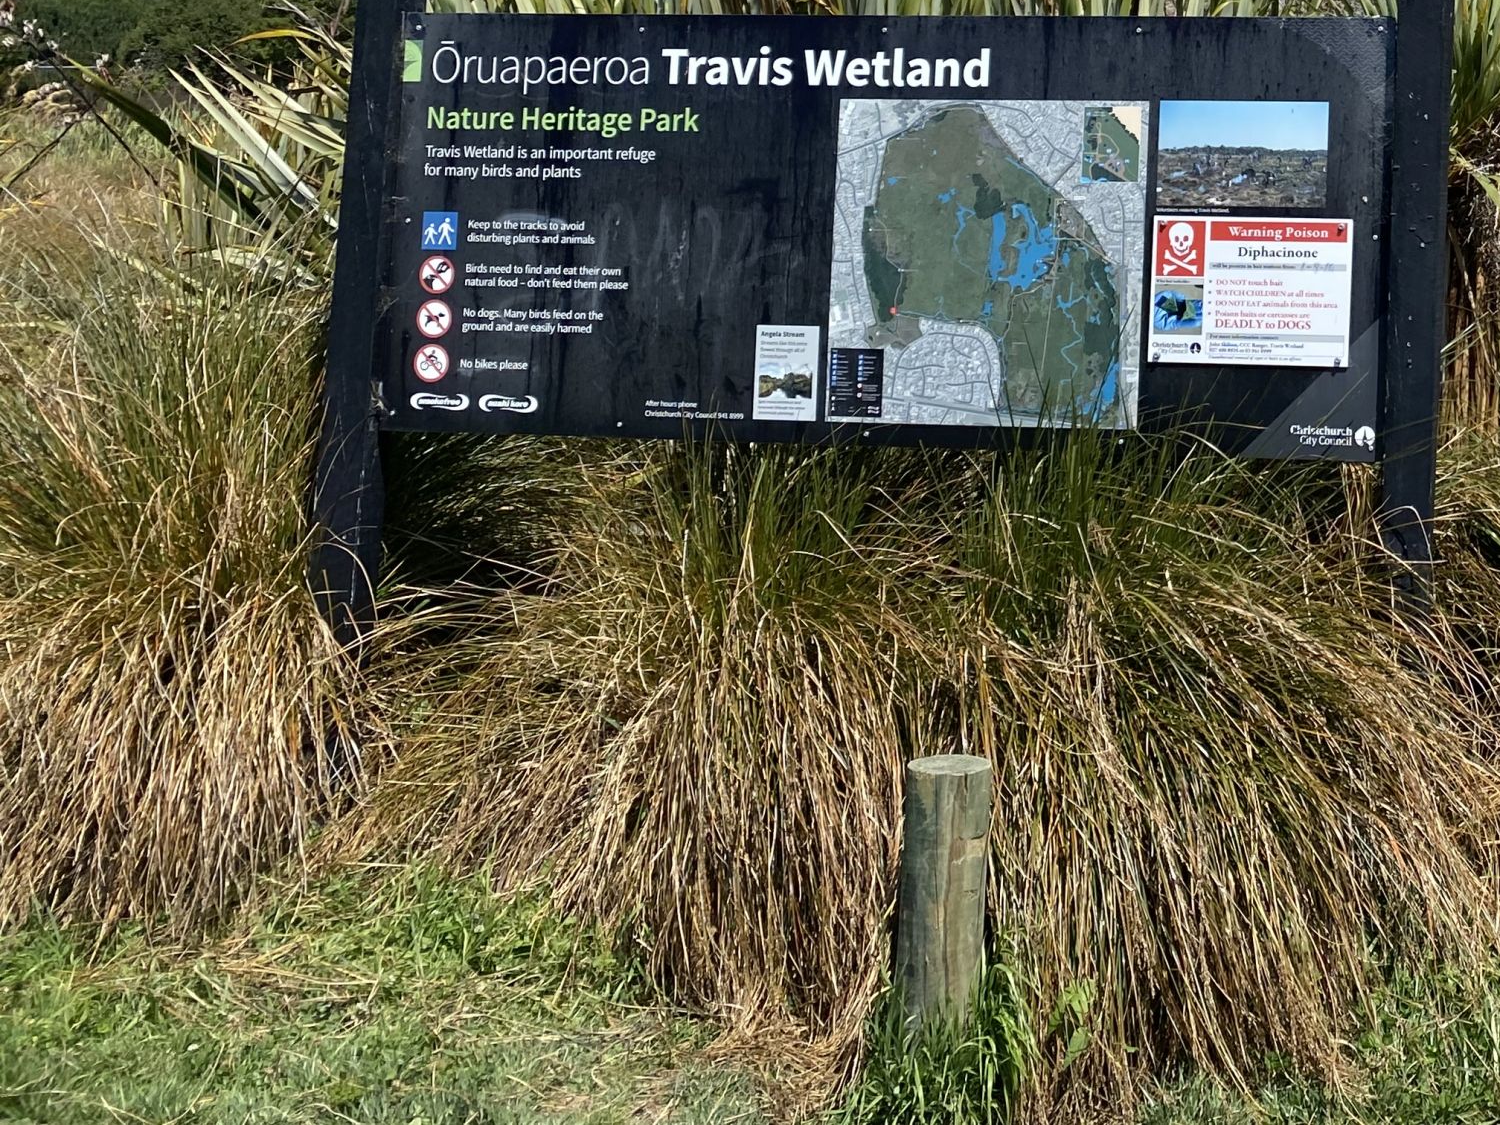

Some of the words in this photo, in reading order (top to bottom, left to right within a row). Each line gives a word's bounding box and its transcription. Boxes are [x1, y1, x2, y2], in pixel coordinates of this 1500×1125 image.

[432, 40, 650, 95] Ōruapaeroa
[662, 45, 793, 87] Travis
[804, 47, 991, 88] Wetland
[427, 106, 514, 131] Nature
[522, 106, 632, 138] Heritage
[640, 107, 700, 133] Park
[426, 145, 461, 159] Travis
[464, 145, 514, 159] Wetland
[517, 146, 528, 160] is
[531, 149, 546, 160] an
[549, 146, 613, 163] important
[616, 147, 656, 164] refuge
[424, 163, 441, 176] for
[444, 166, 479, 180] many
[482, 164, 513, 178] birds
[515, 165, 539, 178] and
[542, 165, 581, 181] plants
[467, 219, 490, 231] Keep
[492, 220, 501, 230] to
[504, 220, 518, 230] the
[520, 221, 547, 230] tracks
[549, 221, 558, 231] to
[560, 221, 585, 231] avoid
[467, 234, 511, 245] disturbing
[513, 234, 540, 245] plants
[542, 234, 558, 244] and
[561, 235, 595, 244] animals
[1228, 226, 1283, 241] Warning
[1286, 227, 1329, 238] Poison
[1238, 246, 1318, 260] Diphacinone
[466, 264, 487, 274] Birds
[489, 264, 511, 274] need
[513, 265, 522, 274] to
[525, 265, 542, 274] find
[544, 265, 561, 275] and
[563, 266, 577, 275] eat
[579, 266, 600, 276] their
[601, 268, 621, 276] own
[465, 277, 495, 287] natural
[498, 278, 518, 287] food
[552, 279, 571, 288] feed
[573, 279, 597, 289] them
[600, 280, 629, 291] please
[463, 308, 475, 317] No
[477, 308, 501, 319] dogs.
[504, 309, 527, 321] Many
[529, 309, 550, 319] birds
[552, 310, 573, 320] feed
[574, 312, 587, 320] on
[588, 311, 603, 321] the
[462, 322, 494, 334] ground
[495, 322, 513, 332] and
[514, 324, 529, 332] are
[530, 323, 555, 335] easily
[557, 324, 592, 334] harmed
[1215, 319, 1263, 329] DEADLY
[1265, 321, 1275, 329] to
[1277, 320, 1311, 330] DOGS
[460, 359, 473, 368] No
[474, 359, 498, 369] bikes
[499, 360, 528, 371] please
[678, 401, 697, 409] phone
[644, 410, 681, 418] Christchurch
[682, 411, 694, 419] City
[695, 411, 717, 419] Council
[1290, 424, 1352, 436] Christchurch
[1300, 435, 1317, 447] City
[1319, 436, 1352, 446] Council
